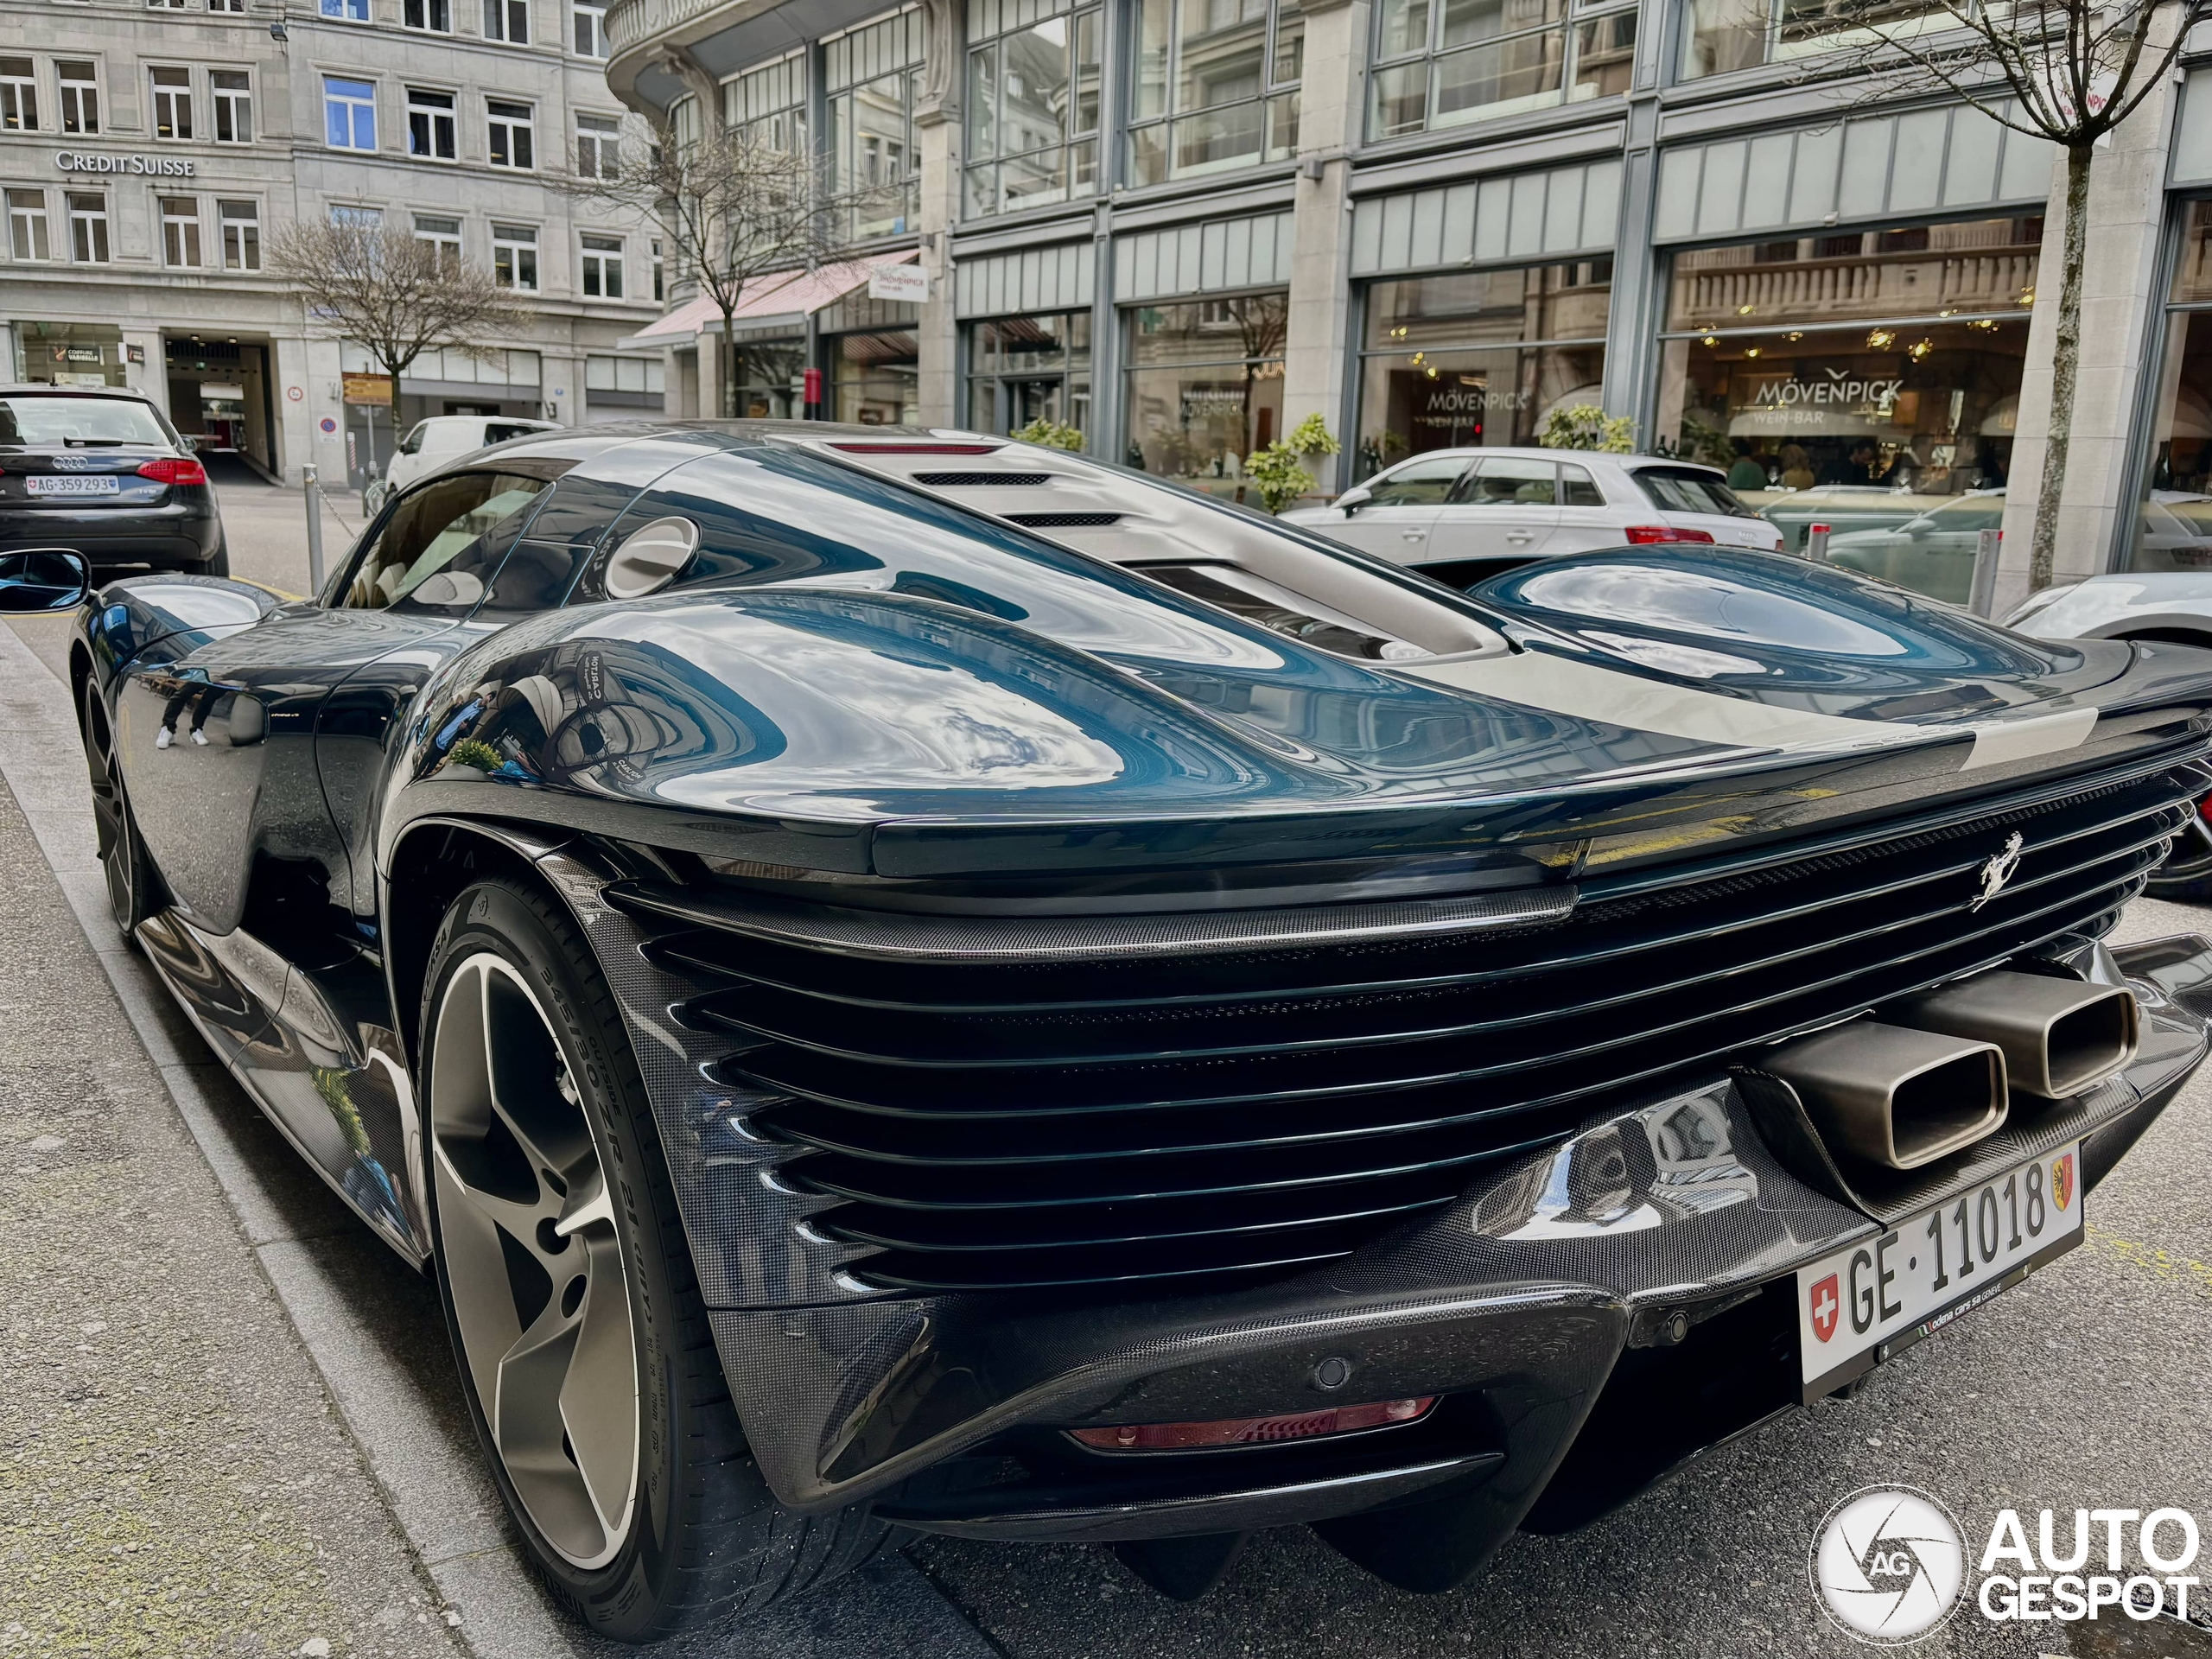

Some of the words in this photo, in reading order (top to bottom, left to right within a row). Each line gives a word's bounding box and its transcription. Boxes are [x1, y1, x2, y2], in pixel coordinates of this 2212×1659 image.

[55, 150, 128, 173] CREDIT
[131, 154, 194, 177] SUISSE
[1427, 389, 1529, 411] MÖVENPICK
[1754, 377, 1904, 404] MÖVENPICK
[588, 1036, 622, 1117] OUTSIDE
[1955, 1300, 1971, 1317] cars
[1972, 1294, 1981, 1306] sa
